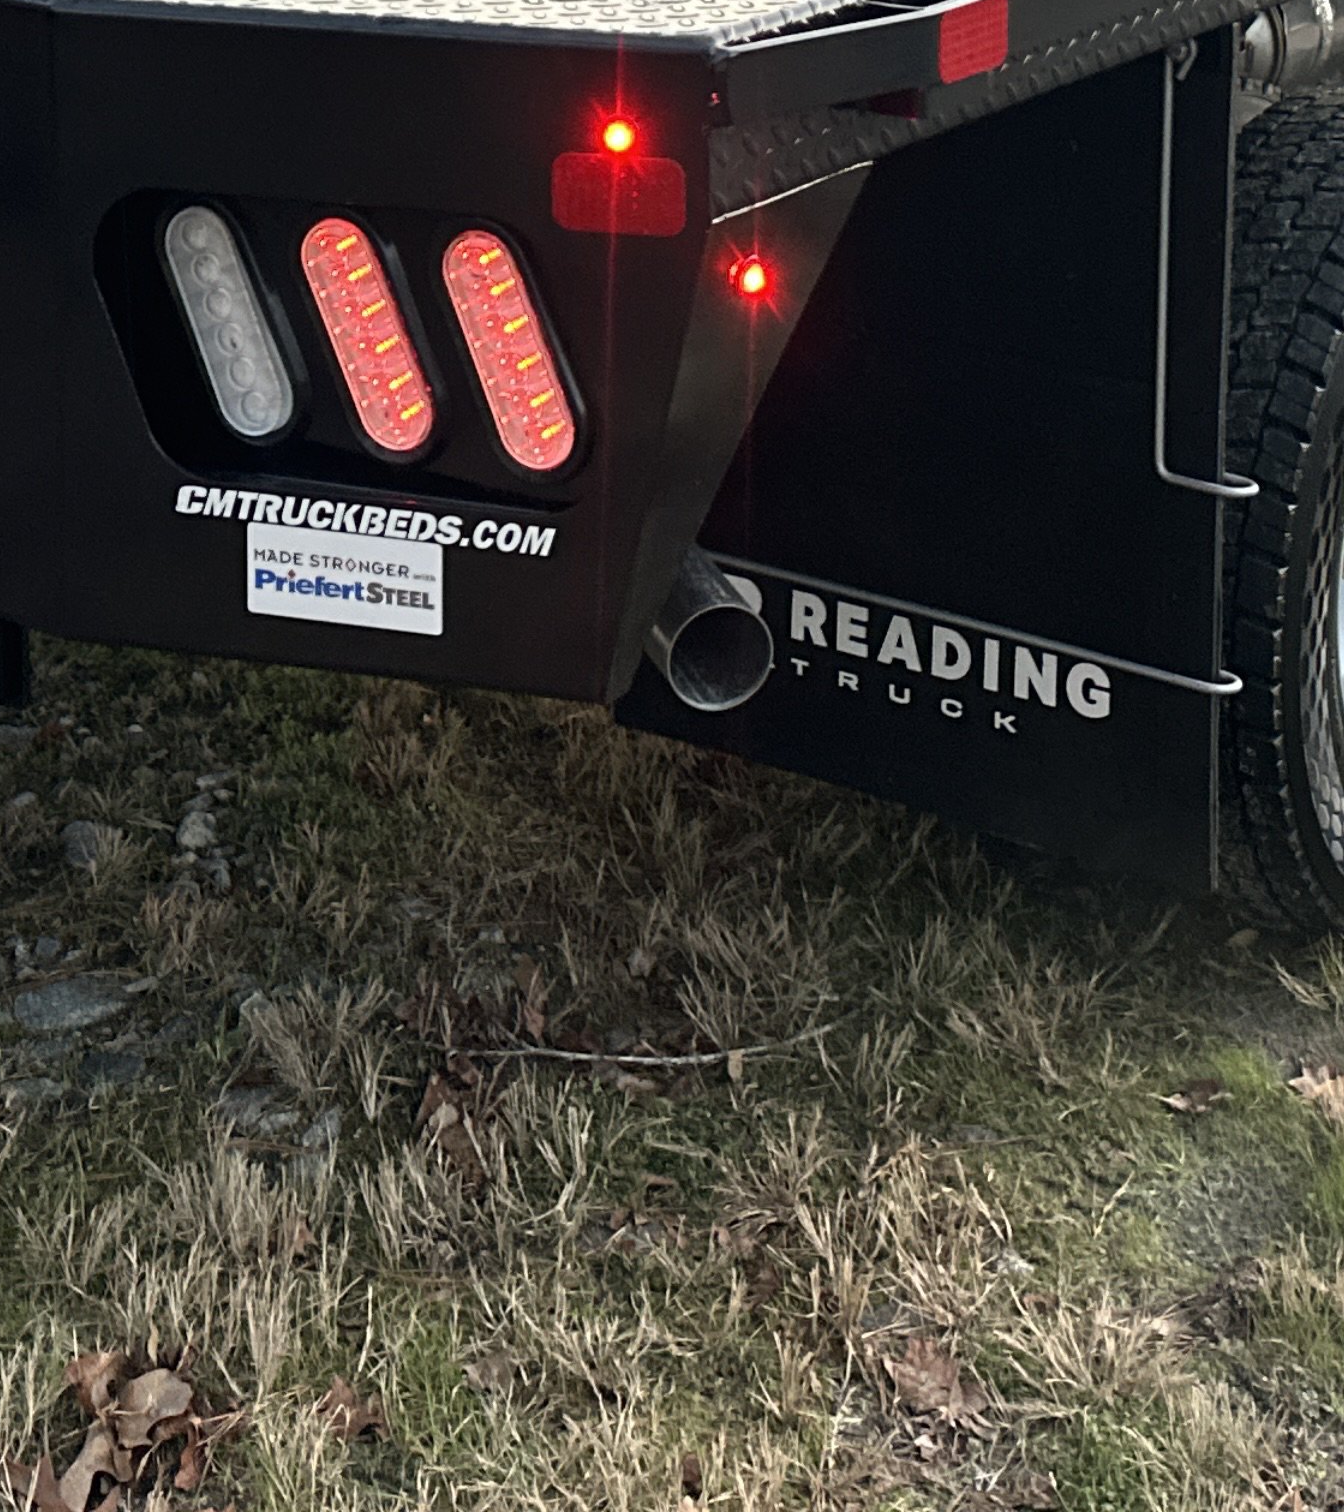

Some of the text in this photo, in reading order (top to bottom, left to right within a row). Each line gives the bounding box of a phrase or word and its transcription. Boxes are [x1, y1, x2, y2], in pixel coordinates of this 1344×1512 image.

[174, 484, 557, 557] CMTRUCKBEDS.COM
[253, 547, 304, 567] MADE
[309, 553, 410, 580] STRONGER
[790, 588, 1112, 719] READING
[790, 657, 1018, 734] TRUCK
